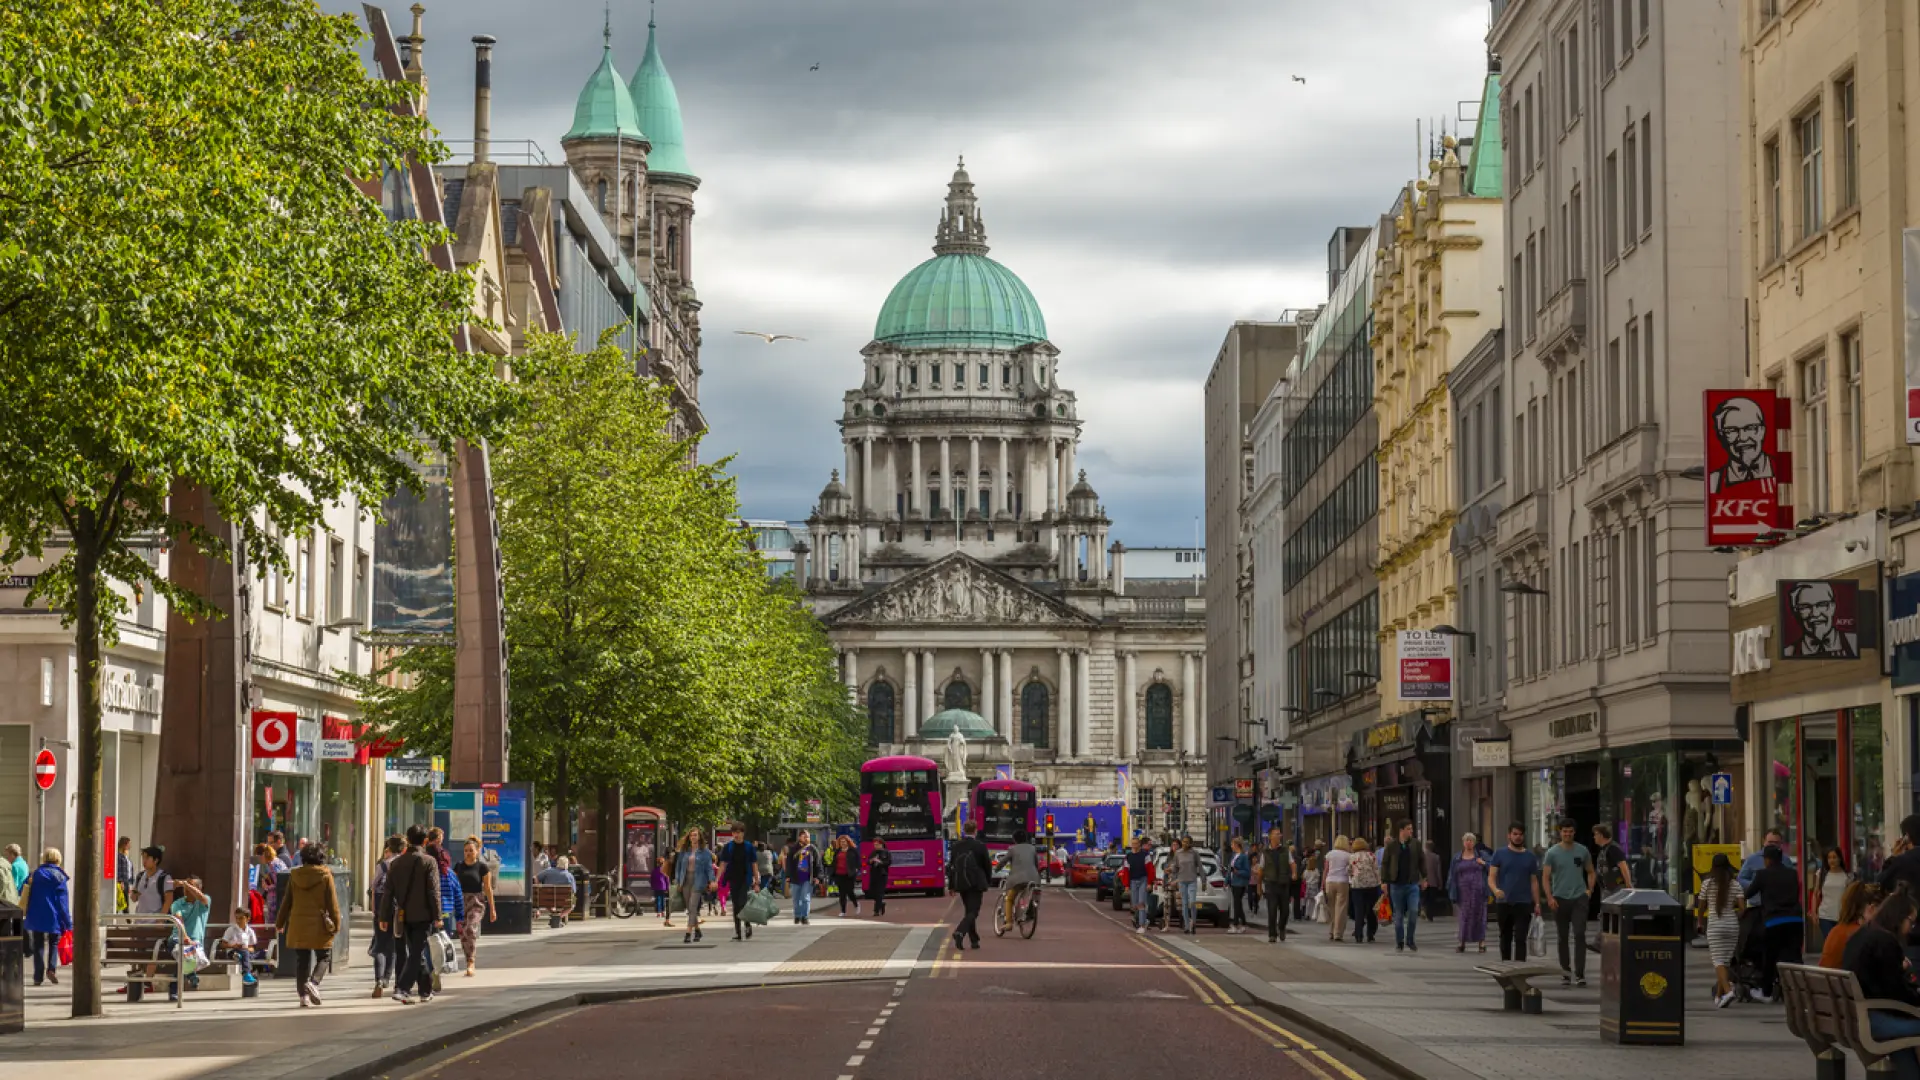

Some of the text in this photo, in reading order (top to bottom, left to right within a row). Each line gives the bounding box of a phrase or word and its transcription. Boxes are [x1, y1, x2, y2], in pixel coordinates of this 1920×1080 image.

[1712, 499, 1769, 517] KFC
[0, 577, 29, 587] ASTLE
[1836, 618, 1854, 626] KFC
[1406, 630, 1443, 640] TO LET
[1732, 625, 1772, 676] KFC
[324, 742, 346, 750] Optical
[1479, 744, 1504, 753] NEW
[323, 749, 348, 757] Express
[1476, 754, 1506, 762] LOOK
[1635, 950, 1672, 960] LITTER
